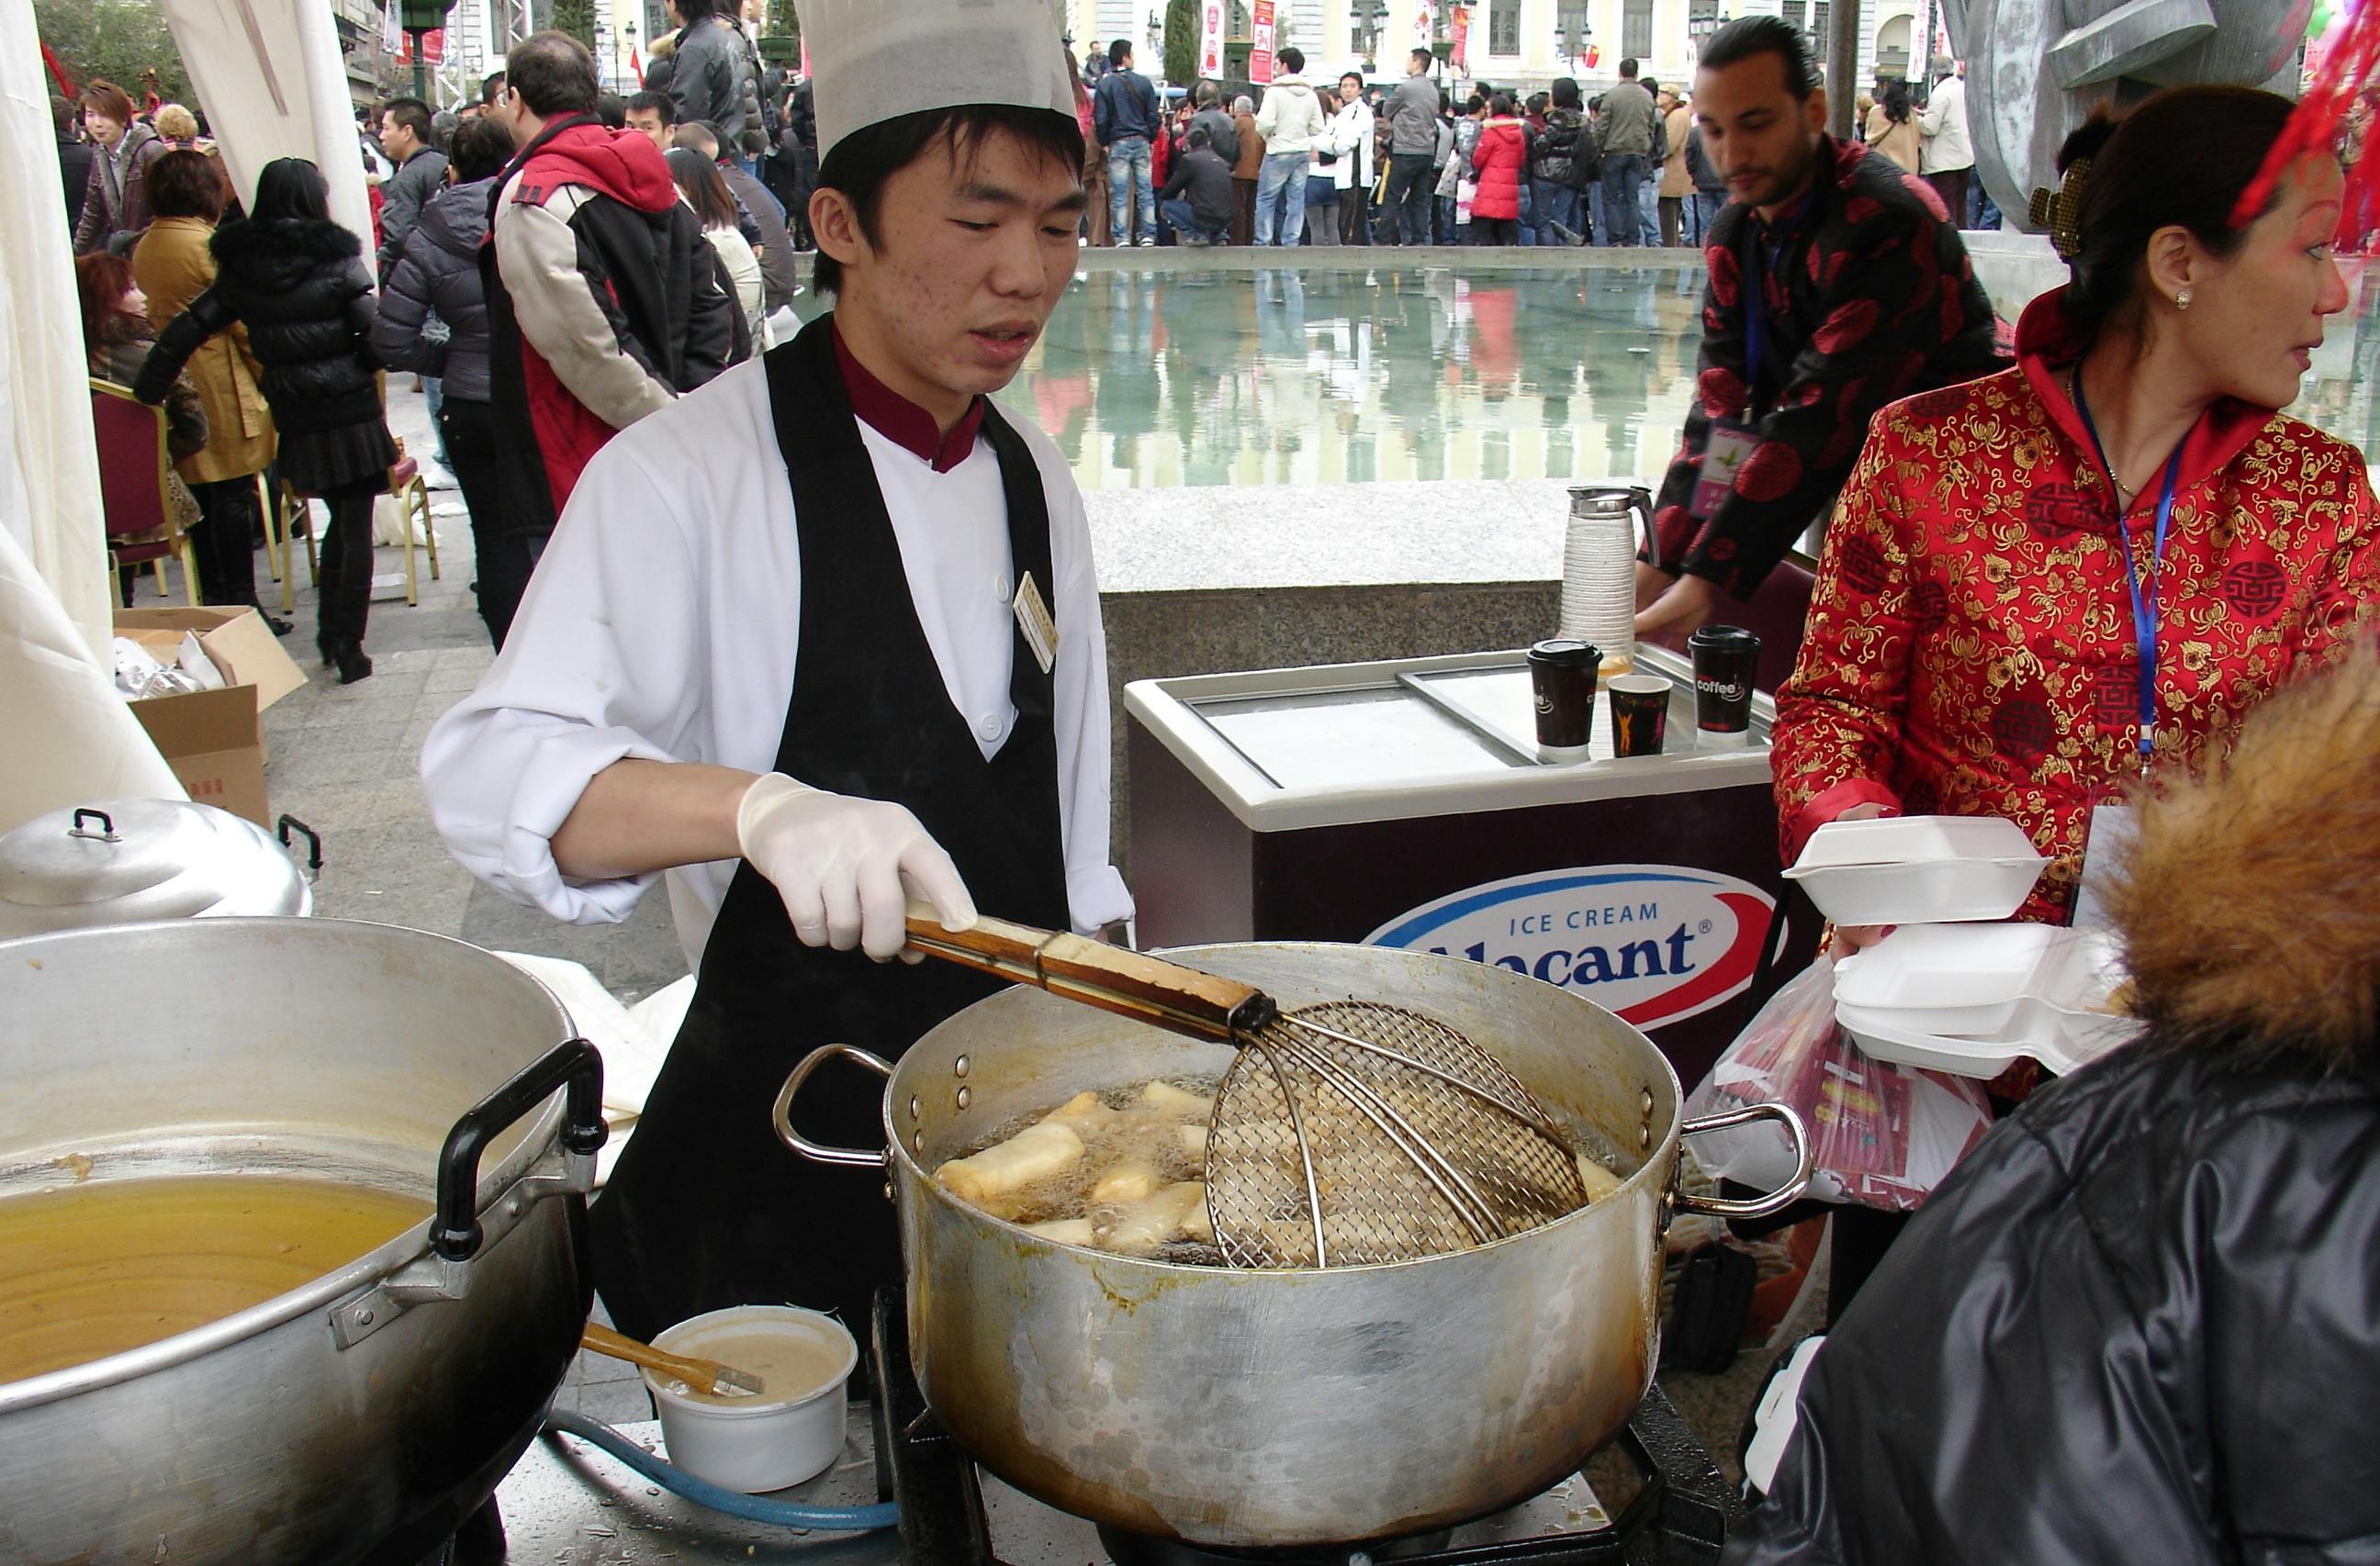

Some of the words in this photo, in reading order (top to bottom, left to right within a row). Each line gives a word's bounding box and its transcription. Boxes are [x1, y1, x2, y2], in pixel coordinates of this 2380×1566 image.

[1697, 679, 1735, 694] coffee
[1510, 914, 1552, 936] ICE
[1566, 903, 1658, 929] CREAM
[1429, 923, 1696, 987] cant
